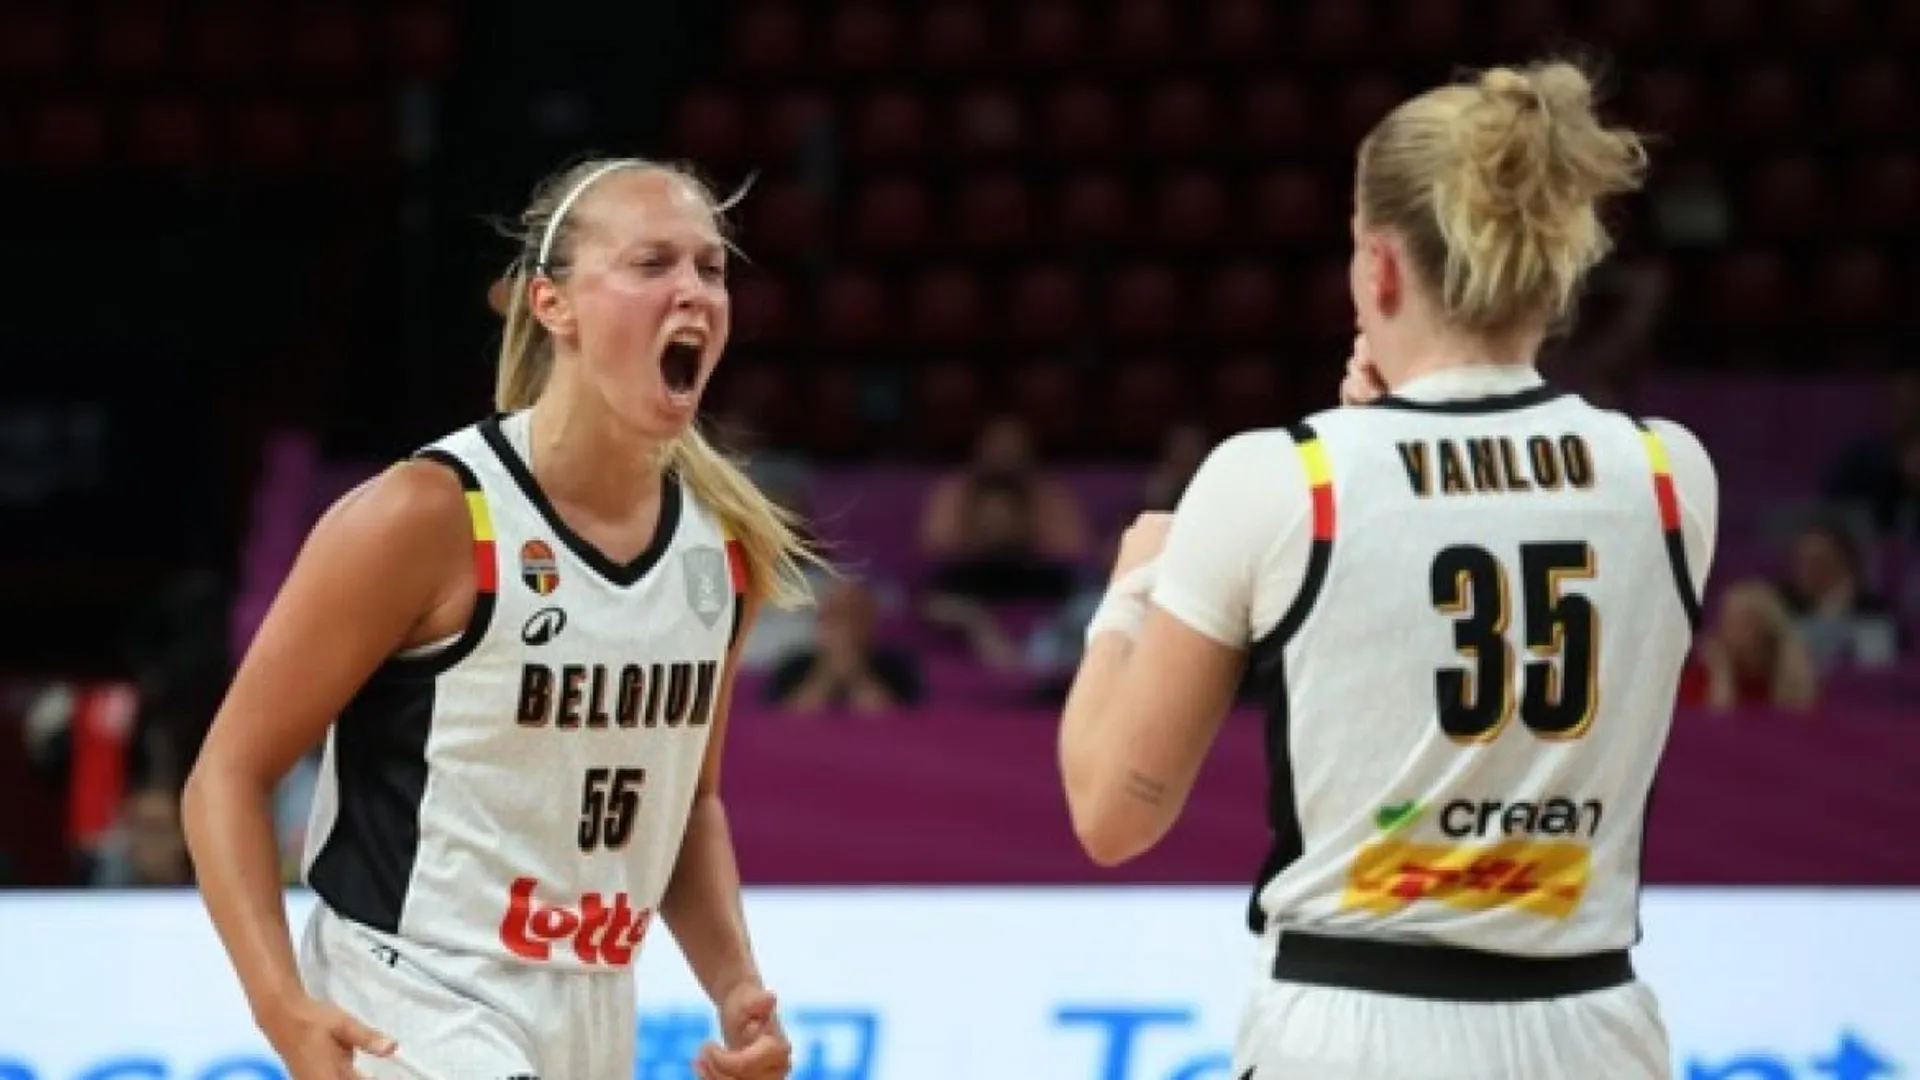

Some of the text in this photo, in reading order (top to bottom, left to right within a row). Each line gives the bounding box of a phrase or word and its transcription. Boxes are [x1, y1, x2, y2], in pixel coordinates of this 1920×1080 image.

[1396, 433, 1594, 497] VANLOO
[1429, 540, 1598, 743] 35
[516, 659, 718, 728] BELGIUM
[577, 767, 646, 851] 55
